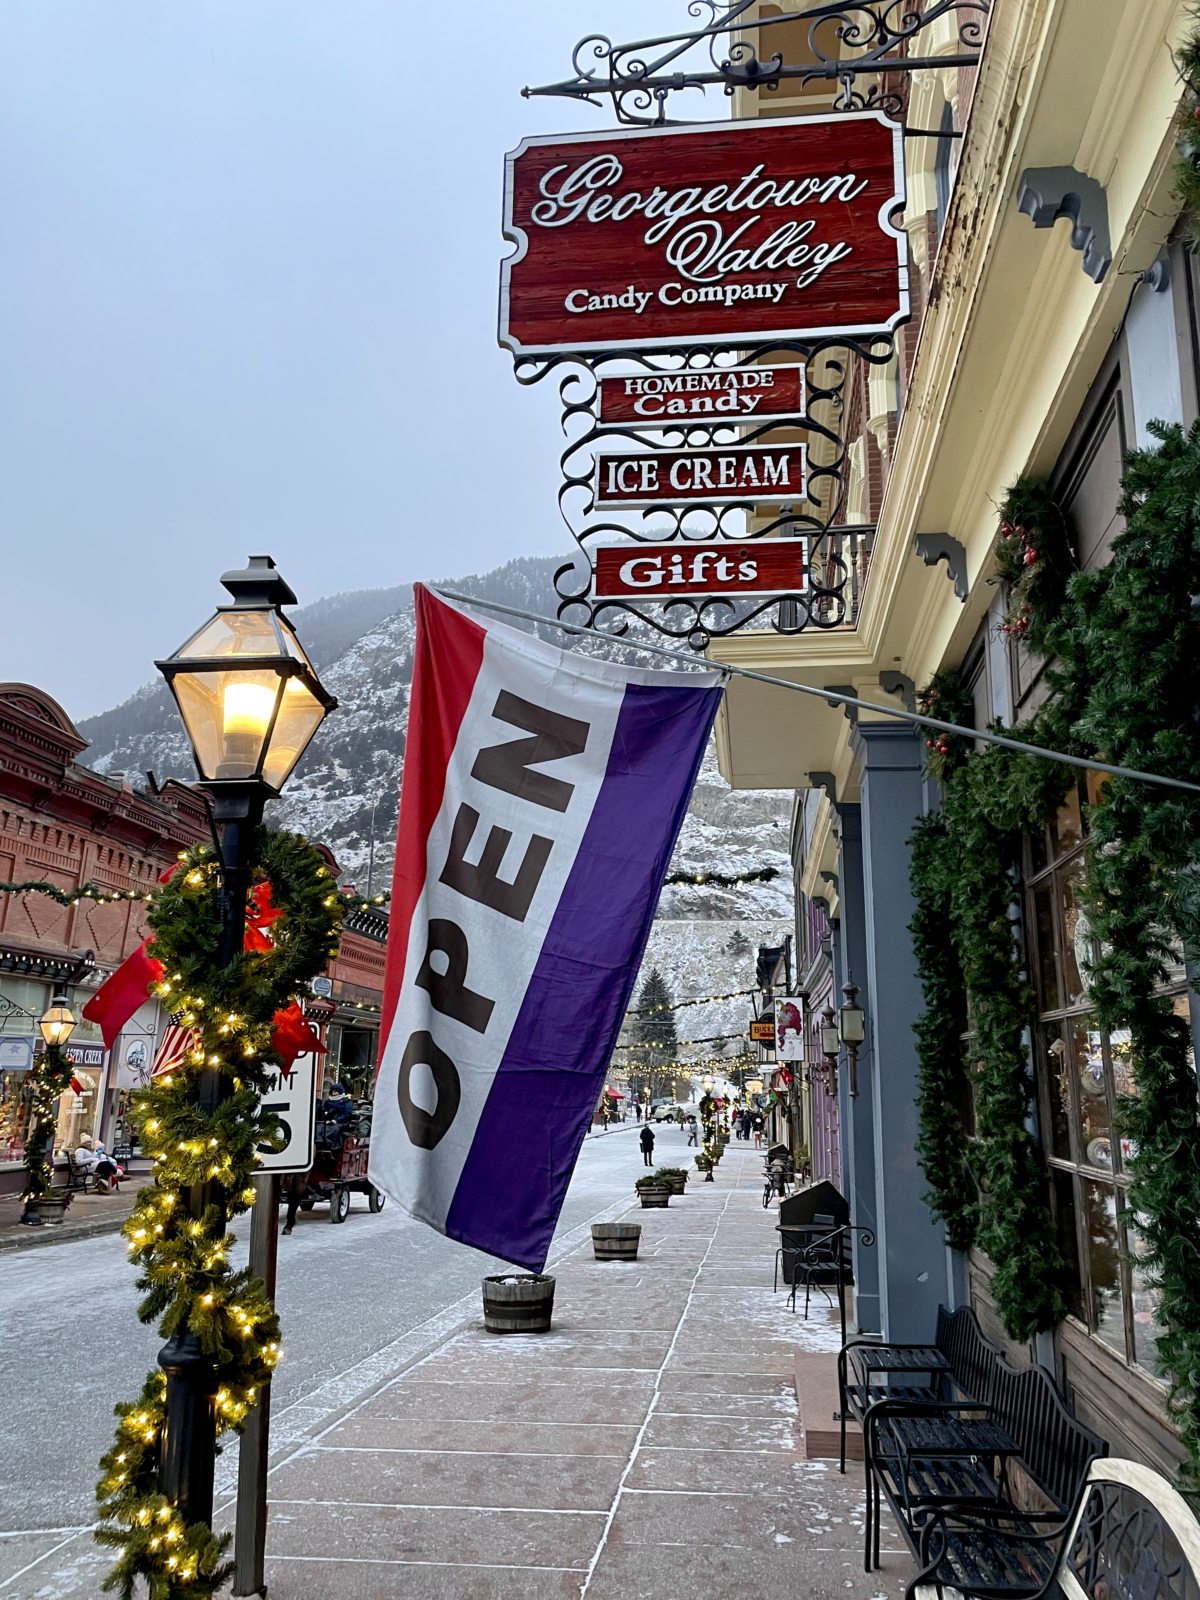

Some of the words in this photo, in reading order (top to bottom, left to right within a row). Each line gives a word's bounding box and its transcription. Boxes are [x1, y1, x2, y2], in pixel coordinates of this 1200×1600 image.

[531, 154, 868, 244] Georgetown
[665, 215, 852, 288] Valley
[564, 286, 653, 313] Candy
[658, 281, 788, 306] Company
[624, 371, 775, 395] HOMEMADE
[633, 388, 763, 416] Candy
[606, 459, 660, 493] ICE
[669, 454, 791, 490] CREAM
[619, 551, 758, 587] Gifts
[398, 689, 590, 1150] OPEN
[85, 1049, 103, 1064] CREEK
